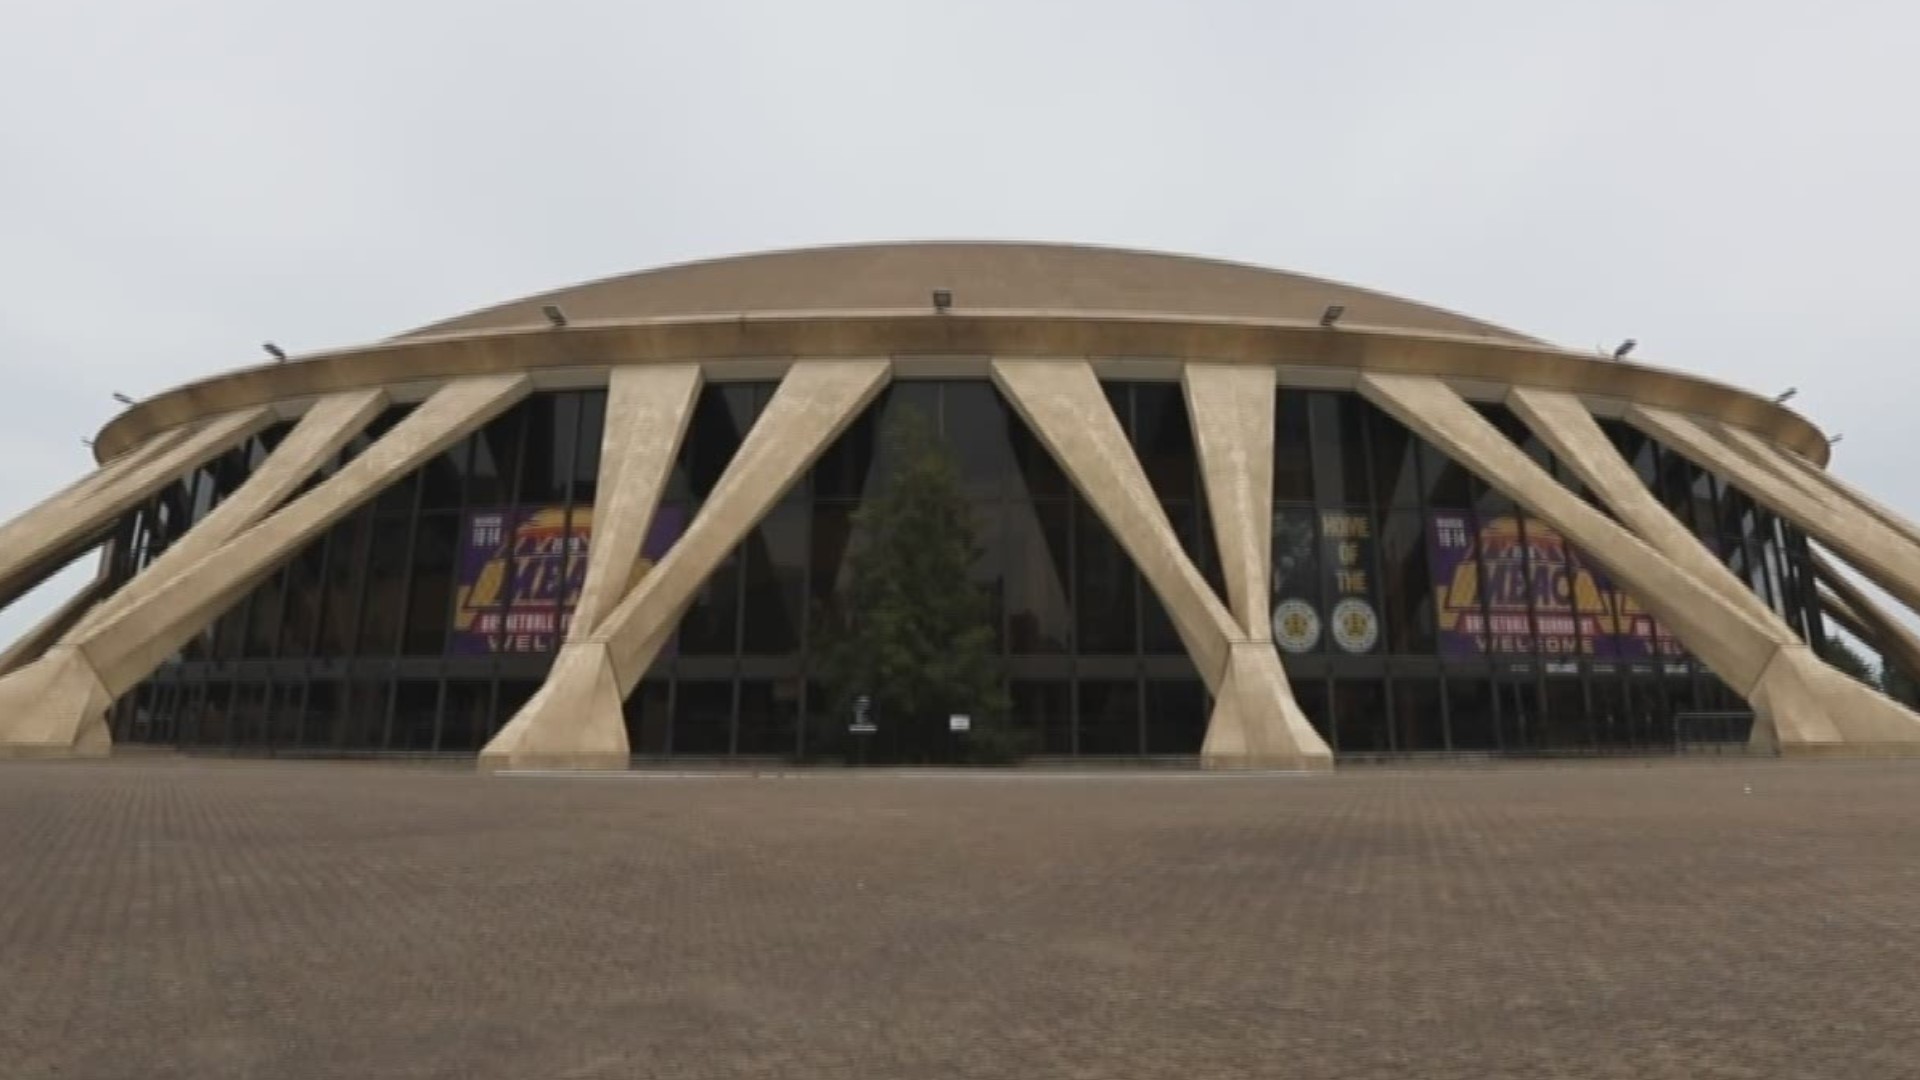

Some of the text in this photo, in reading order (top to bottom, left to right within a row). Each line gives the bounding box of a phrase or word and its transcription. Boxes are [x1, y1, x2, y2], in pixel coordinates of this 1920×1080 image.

[1322, 515, 1370, 537] HOME
[1338, 542, 1359, 566] OF
[1335, 570, 1368, 592] THE
[1474, 635, 1594, 653] WELCOME
